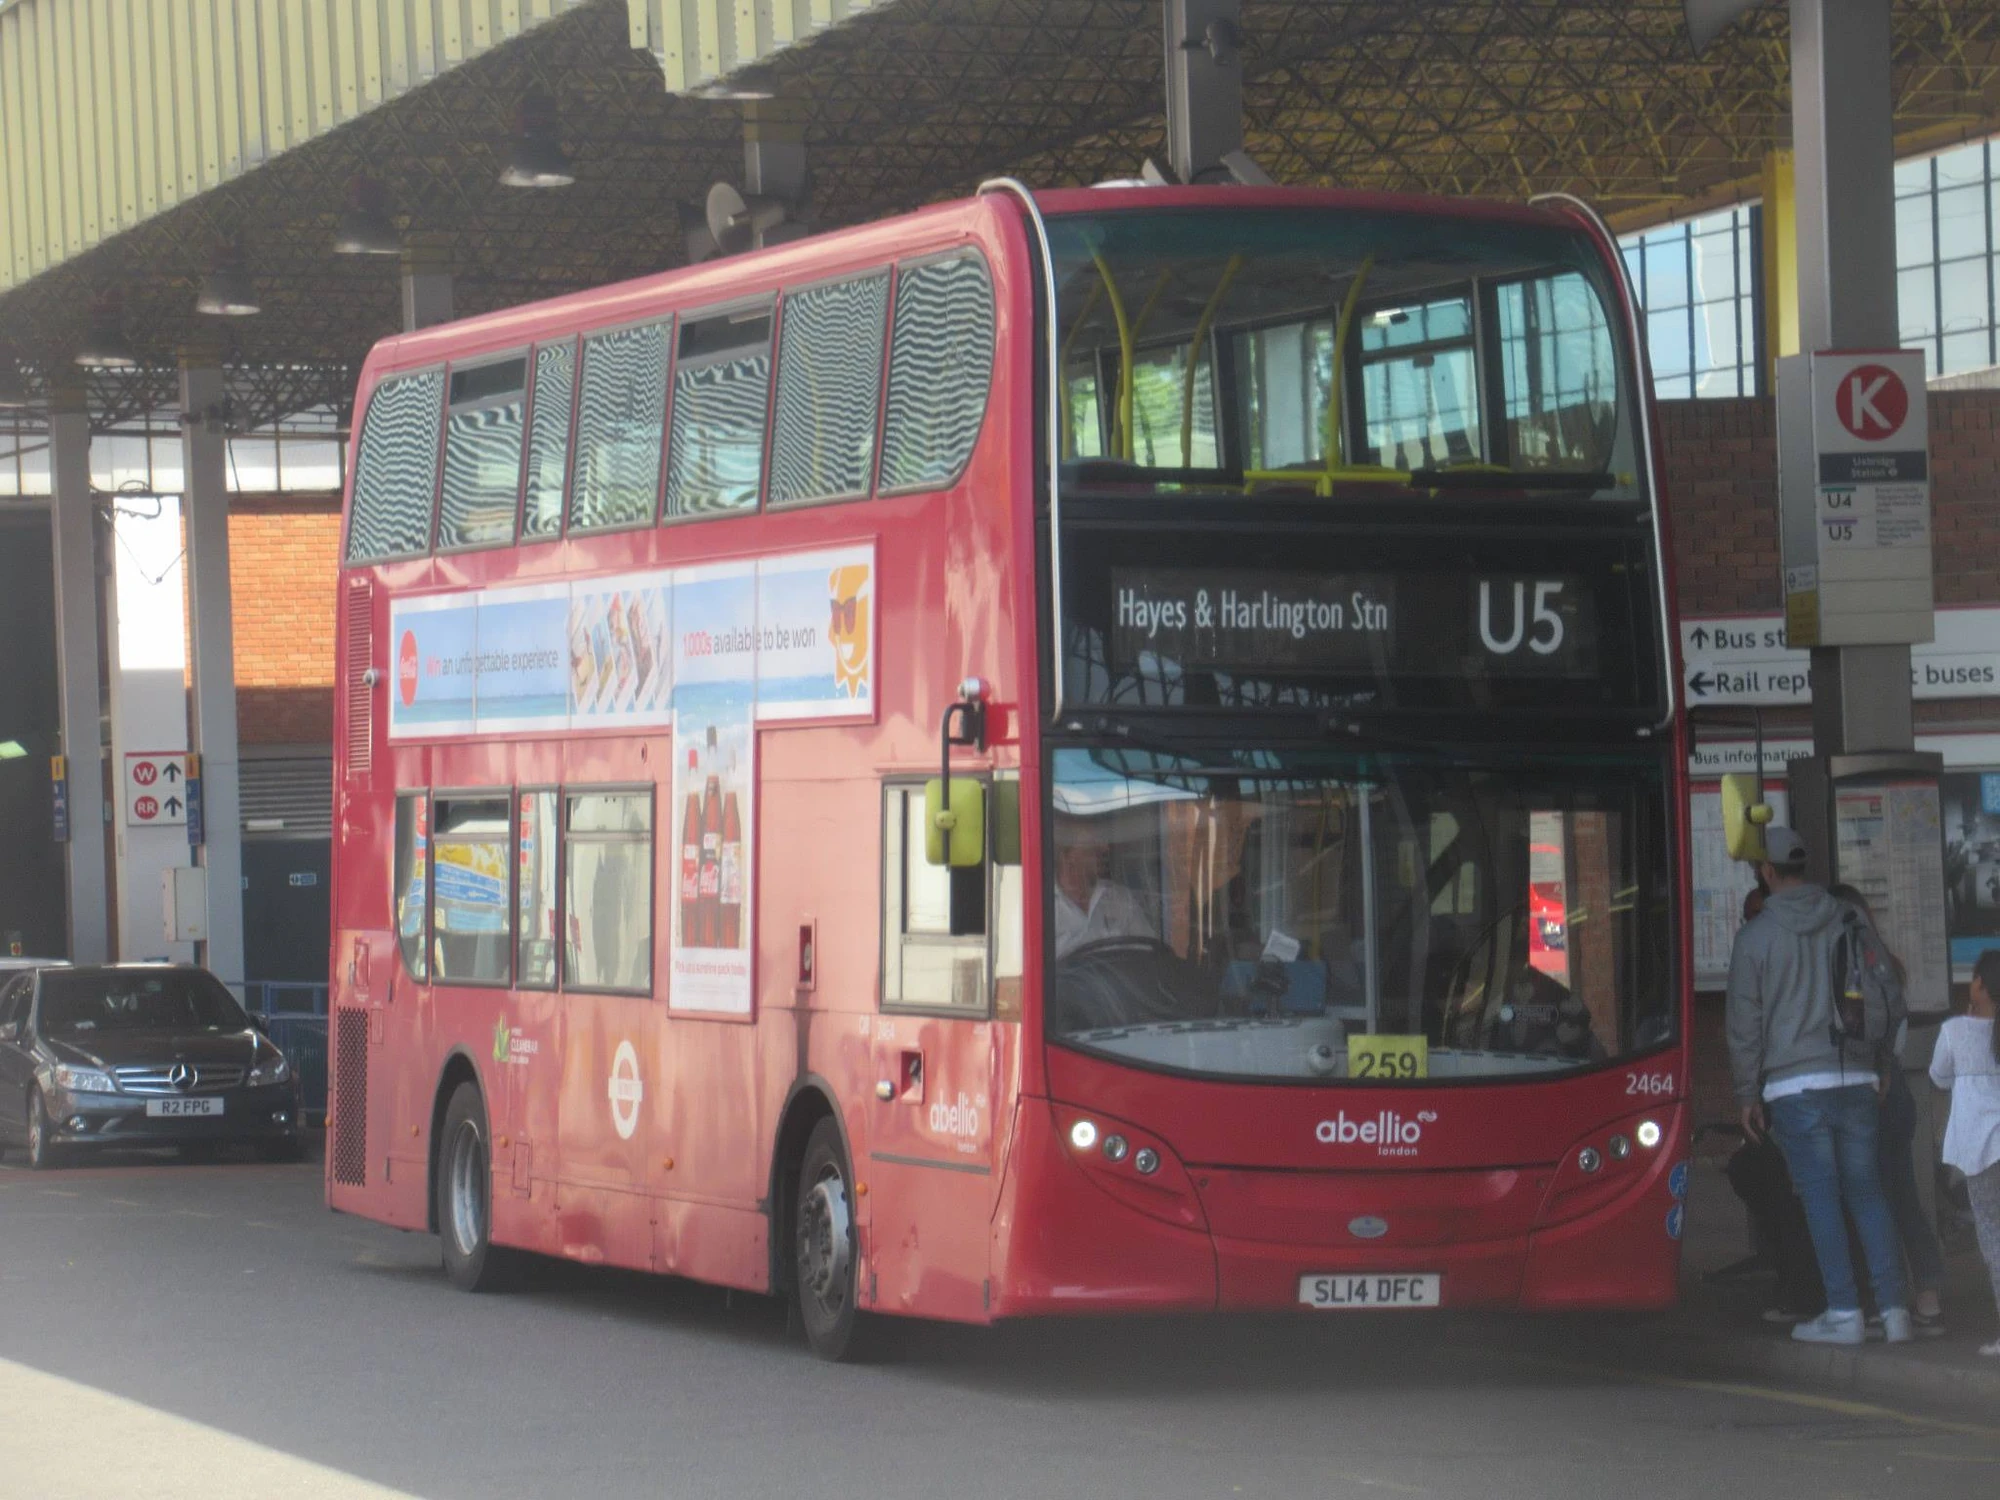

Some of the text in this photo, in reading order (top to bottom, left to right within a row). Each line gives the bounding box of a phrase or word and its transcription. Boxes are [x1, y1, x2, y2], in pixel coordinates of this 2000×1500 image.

[1852, 376, 1892, 430] K
[1827, 492, 1852, 509] U4
[1828, 525, 1853, 541] U5
[1118, 589, 1388, 639] Hayes & Harlington Stn
[1480, 580, 1565, 654] U5
[714, 625, 762, 655] available
[764, 626, 774, 651] to
[776, 623, 790, 651] be
[792, 626, 817, 649] won
[1714, 629, 1757, 649] Bus
[455, 649, 509, 680] unfogettable
[511, 645, 559, 677] experience
[1716, 670, 1761, 694] Rail
[1926, 664, 1994, 685] buses
[1694, 751, 1720, 765] Bus
[136, 767, 154, 782] W
[137, 802, 156, 814] RR
[1358, 1052, 1418, 1079] 259
[1625, 1073, 1674, 1095] 2464
[162, 1100, 210, 1114] R2 FPG
[930, 1088, 978, 1137] abellio
[1315, 1109, 1421, 1144] abellio
[1378, 1147, 1418, 1156] london
[1314, 1278, 1424, 1303] SL14 DFC
